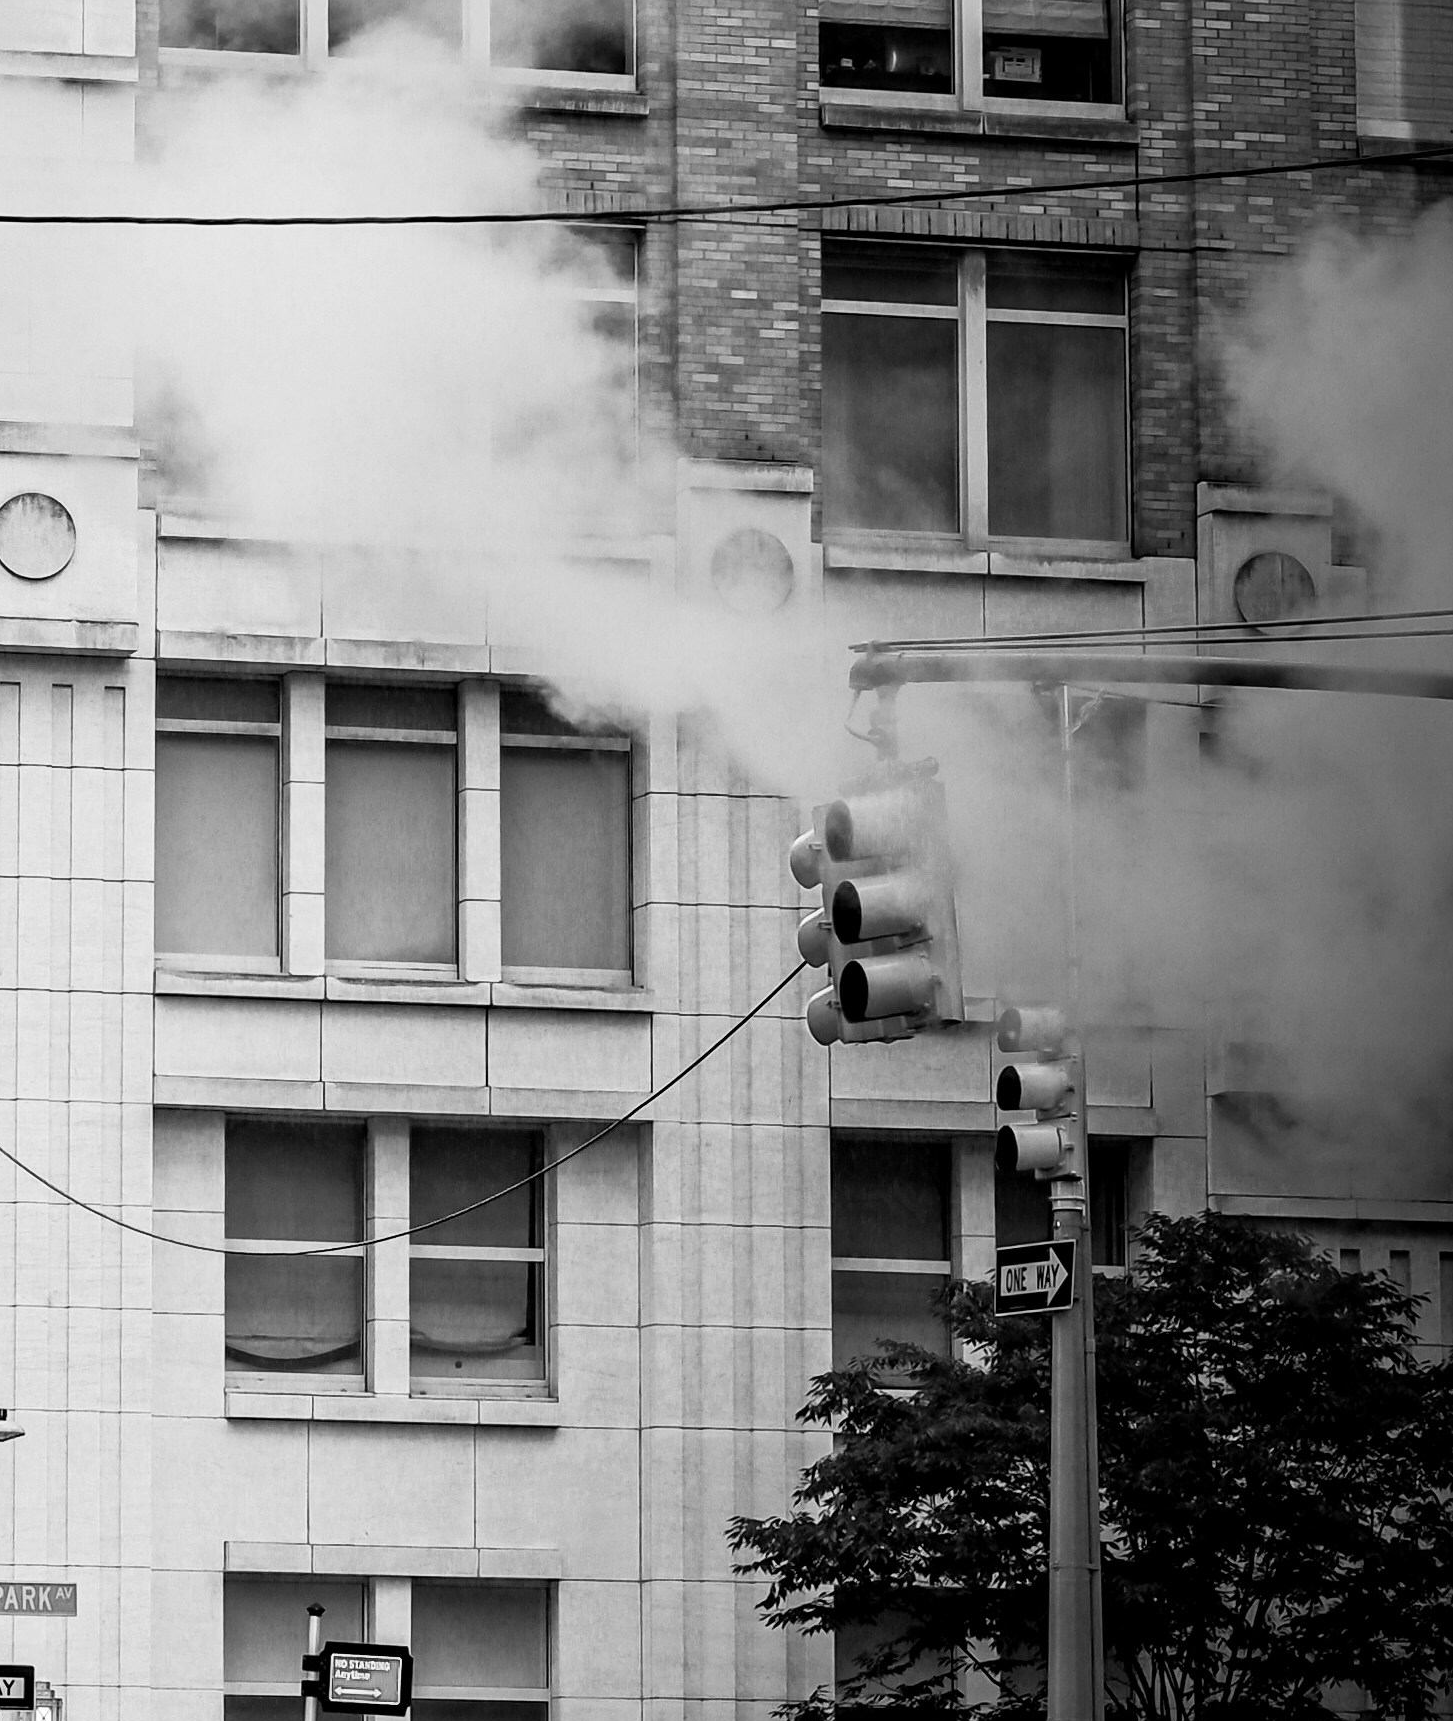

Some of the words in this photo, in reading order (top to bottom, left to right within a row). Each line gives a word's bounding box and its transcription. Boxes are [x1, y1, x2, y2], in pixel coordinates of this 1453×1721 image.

[1006, 1266, 1027, 1293] ONE
[1036, 1263, 1060, 1290] WAY
[55, 1586, 73, 1599] AV
[334, 1659, 348, 1669] NO
[349, 1659, 391, 1671] STANDING
[334, 1669, 371, 1681] Anytime
